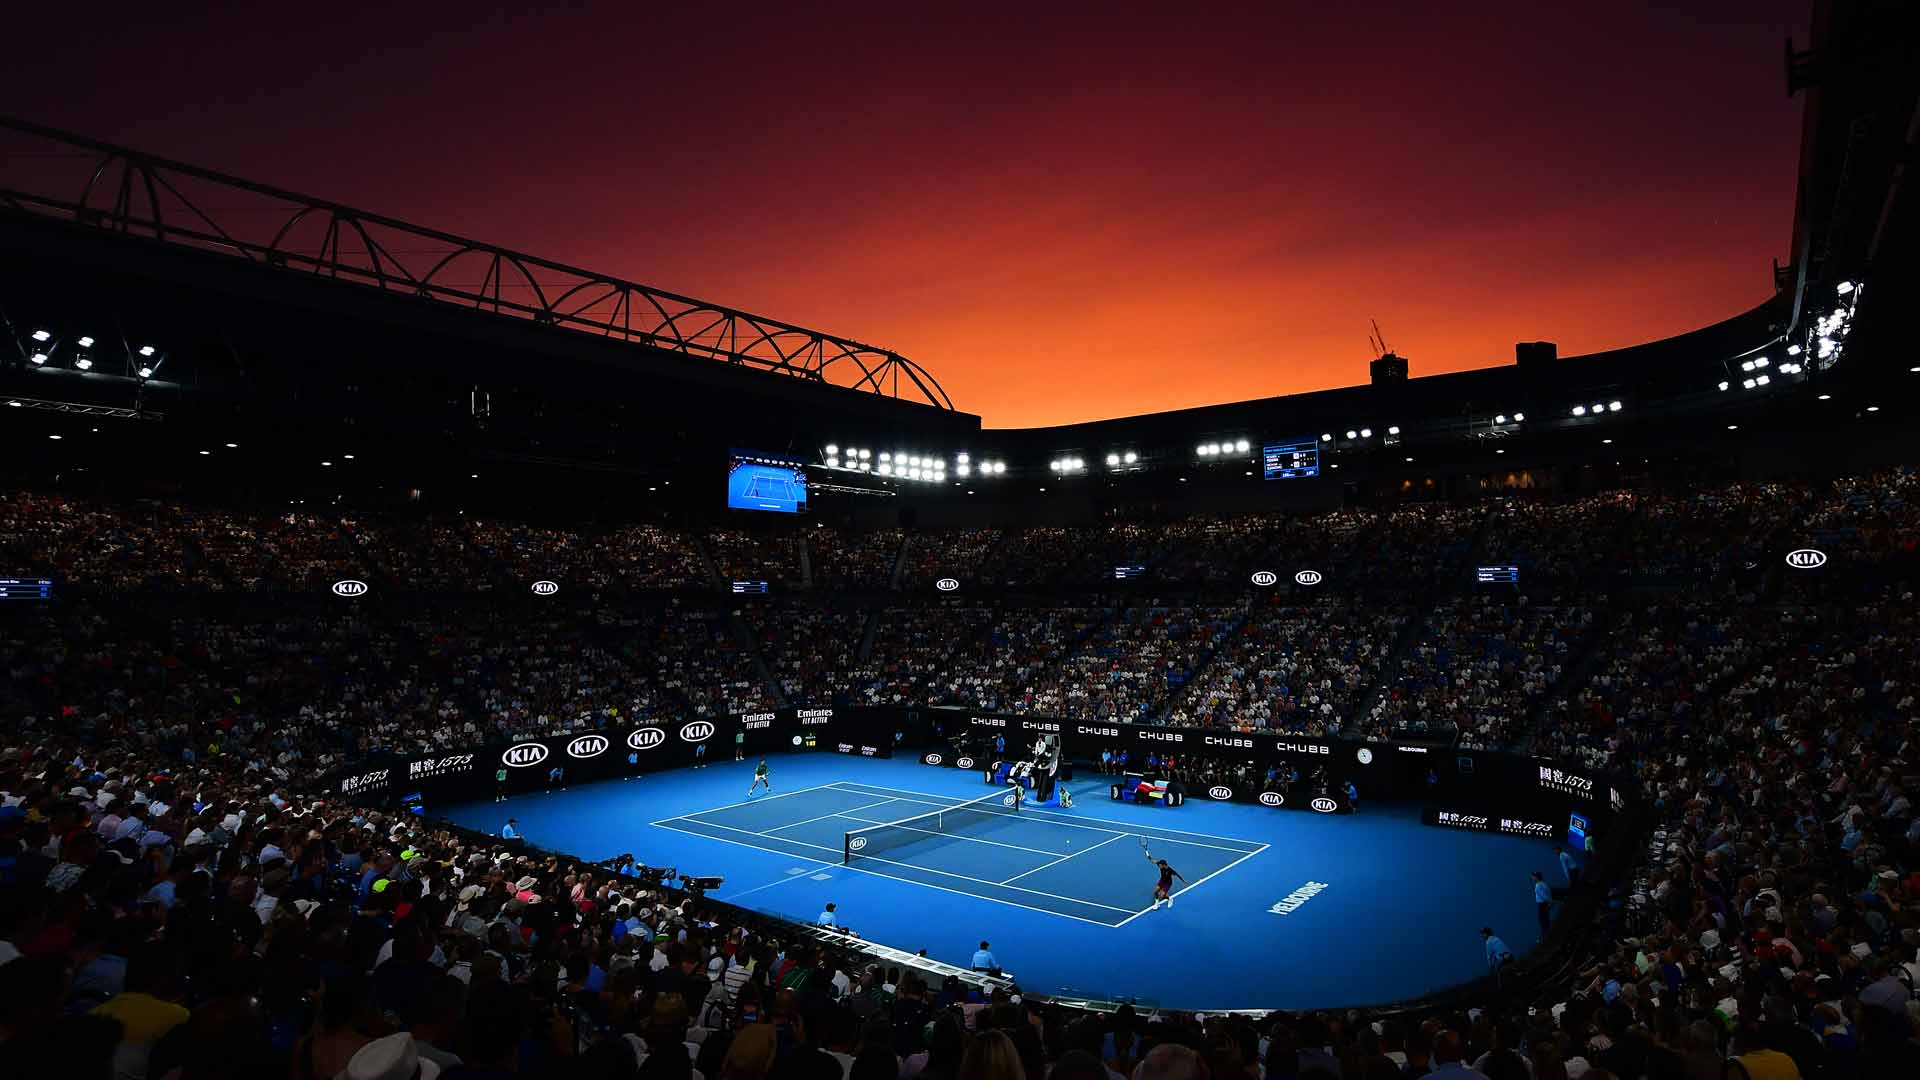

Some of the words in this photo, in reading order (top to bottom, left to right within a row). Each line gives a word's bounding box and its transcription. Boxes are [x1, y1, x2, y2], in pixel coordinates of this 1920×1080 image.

[742, 712, 775, 723] Emirates
[797, 708, 833, 718] Emirates
[971, 717, 1006, 727] CHUBB
[1022, 721, 1060, 731] CHUBB
[1078, 726, 1119, 736] CHUBB
[1139, 731, 1183, 742] CHUBB
[1205, 736, 1253, 748] CHUBB
[1277, 742, 1329, 754] CHUBB
